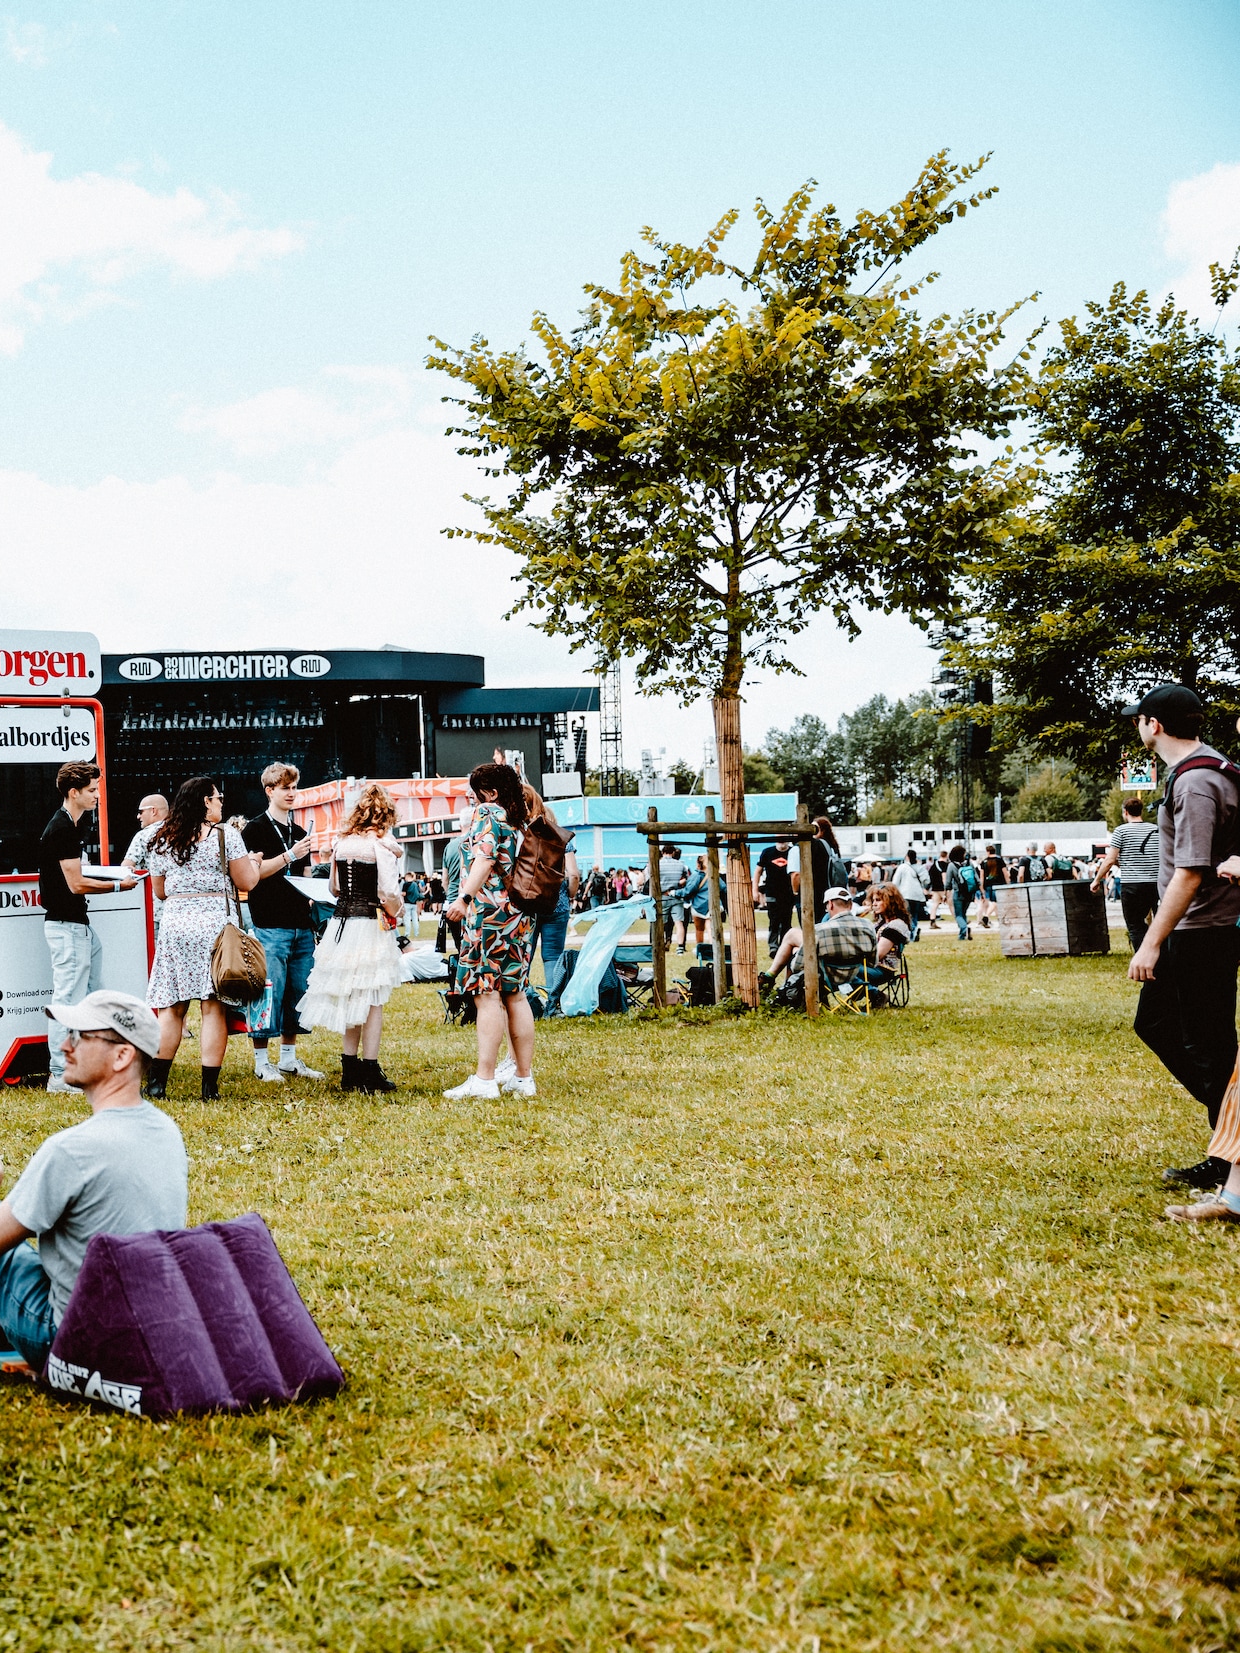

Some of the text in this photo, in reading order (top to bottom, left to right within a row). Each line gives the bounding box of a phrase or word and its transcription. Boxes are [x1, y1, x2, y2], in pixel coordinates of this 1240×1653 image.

[6, 989, 40, 999] Download
[6, 1006, 23, 1016] Krijg
[23, 1005, 40, 1015] jouw
